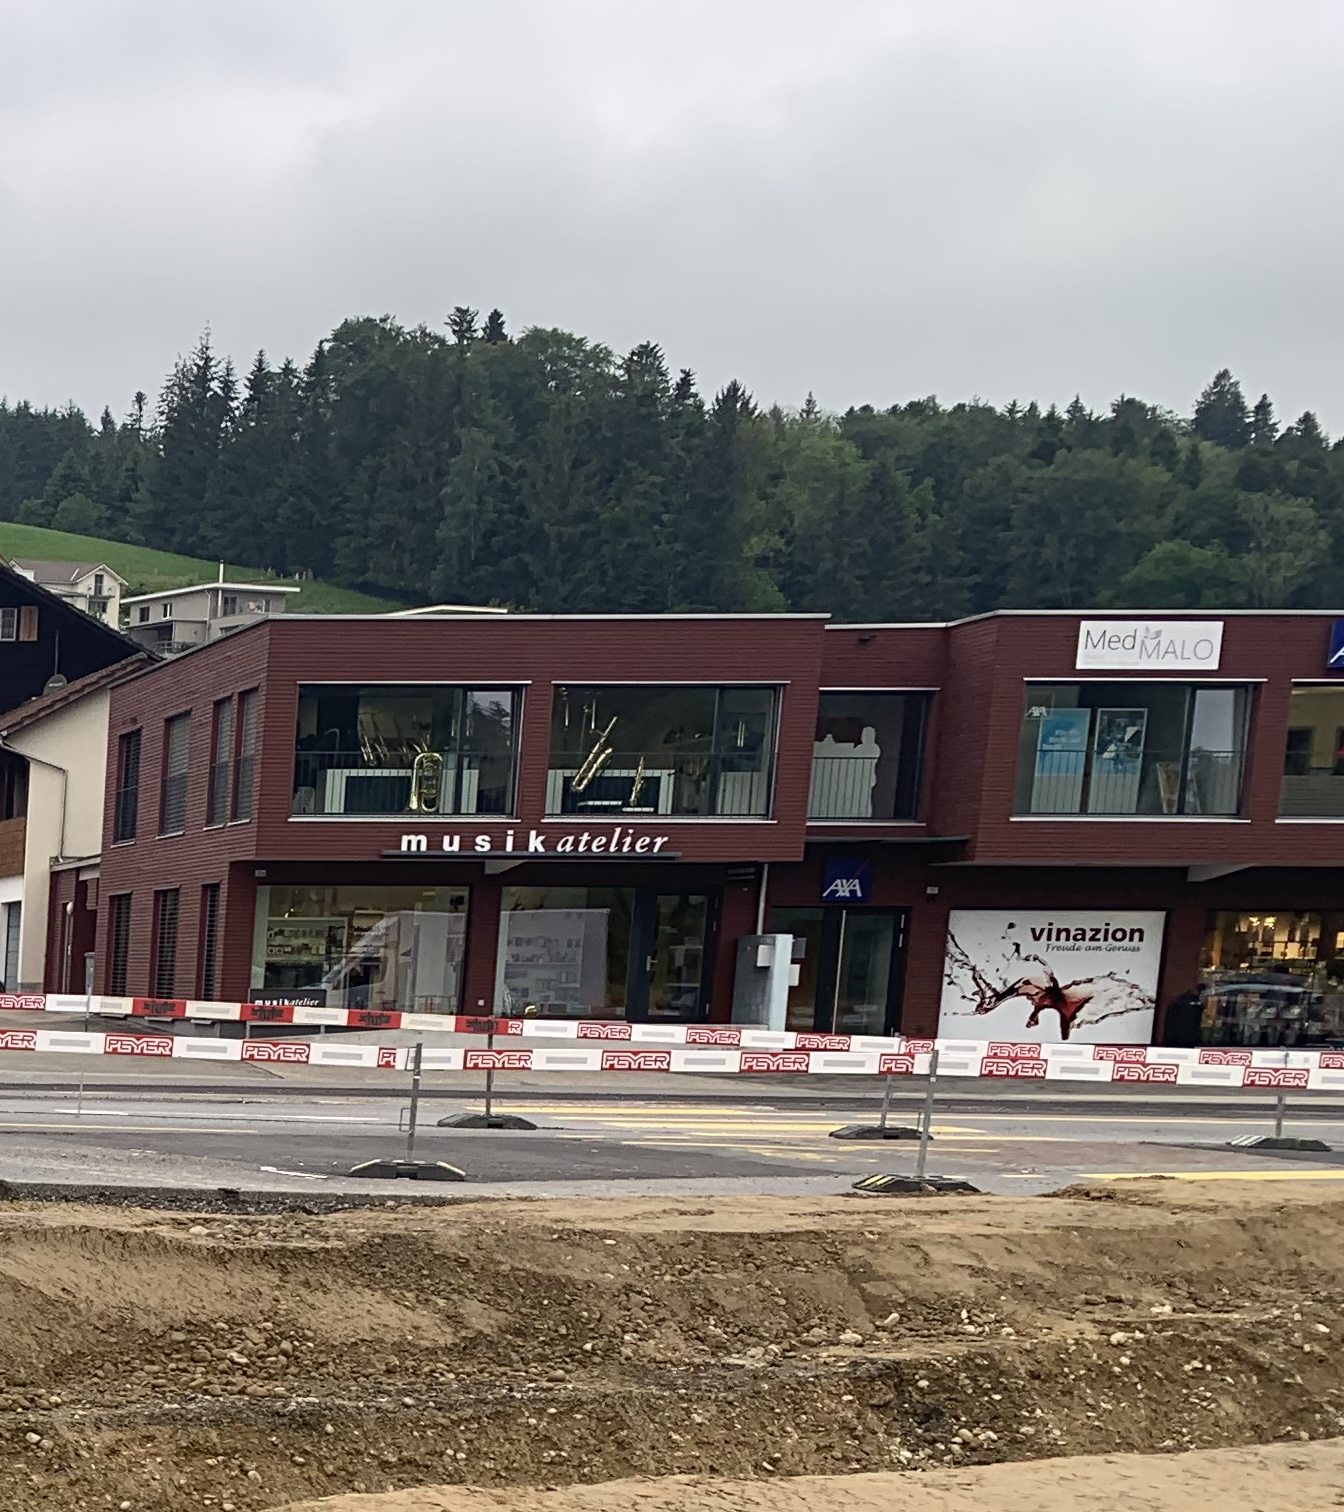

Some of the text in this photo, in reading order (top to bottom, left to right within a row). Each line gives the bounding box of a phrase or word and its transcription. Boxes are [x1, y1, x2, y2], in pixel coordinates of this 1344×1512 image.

[1084, 629, 1138, 651] Med
[1139, 639, 1214, 661] MALO
[822, 879, 862, 897] AXA
[1030, 922, 1145, 943] vinazion
[1045, 943, 1141, 953] Freude am Genuss
[578, 1024, 631, 1040] PEYER
[688, 1029, 740, 1045] PEYER
[106, 1036, 173, 1054] PEYER
[796, 1036, 850, 1049] PEYER
[988, 1044, 1040, 1058] PEYER
[242, 1043, 309, 1061] PEYER
[466, 1051, 533, 1069] PEYER
[1095, 1048, 1146, 1062] PEYER
[1200, 1051, 1251, 1066] PEYER
[603, 1053, 670, 1070] PEYER
[741, 1054, 808, 1071] PEYER
[982, 1059, 1046, 1076] PEYER
[1113, 1064, 1177, 1081] PEYER
[1245, 1068, 1308, 1086] PEYER
